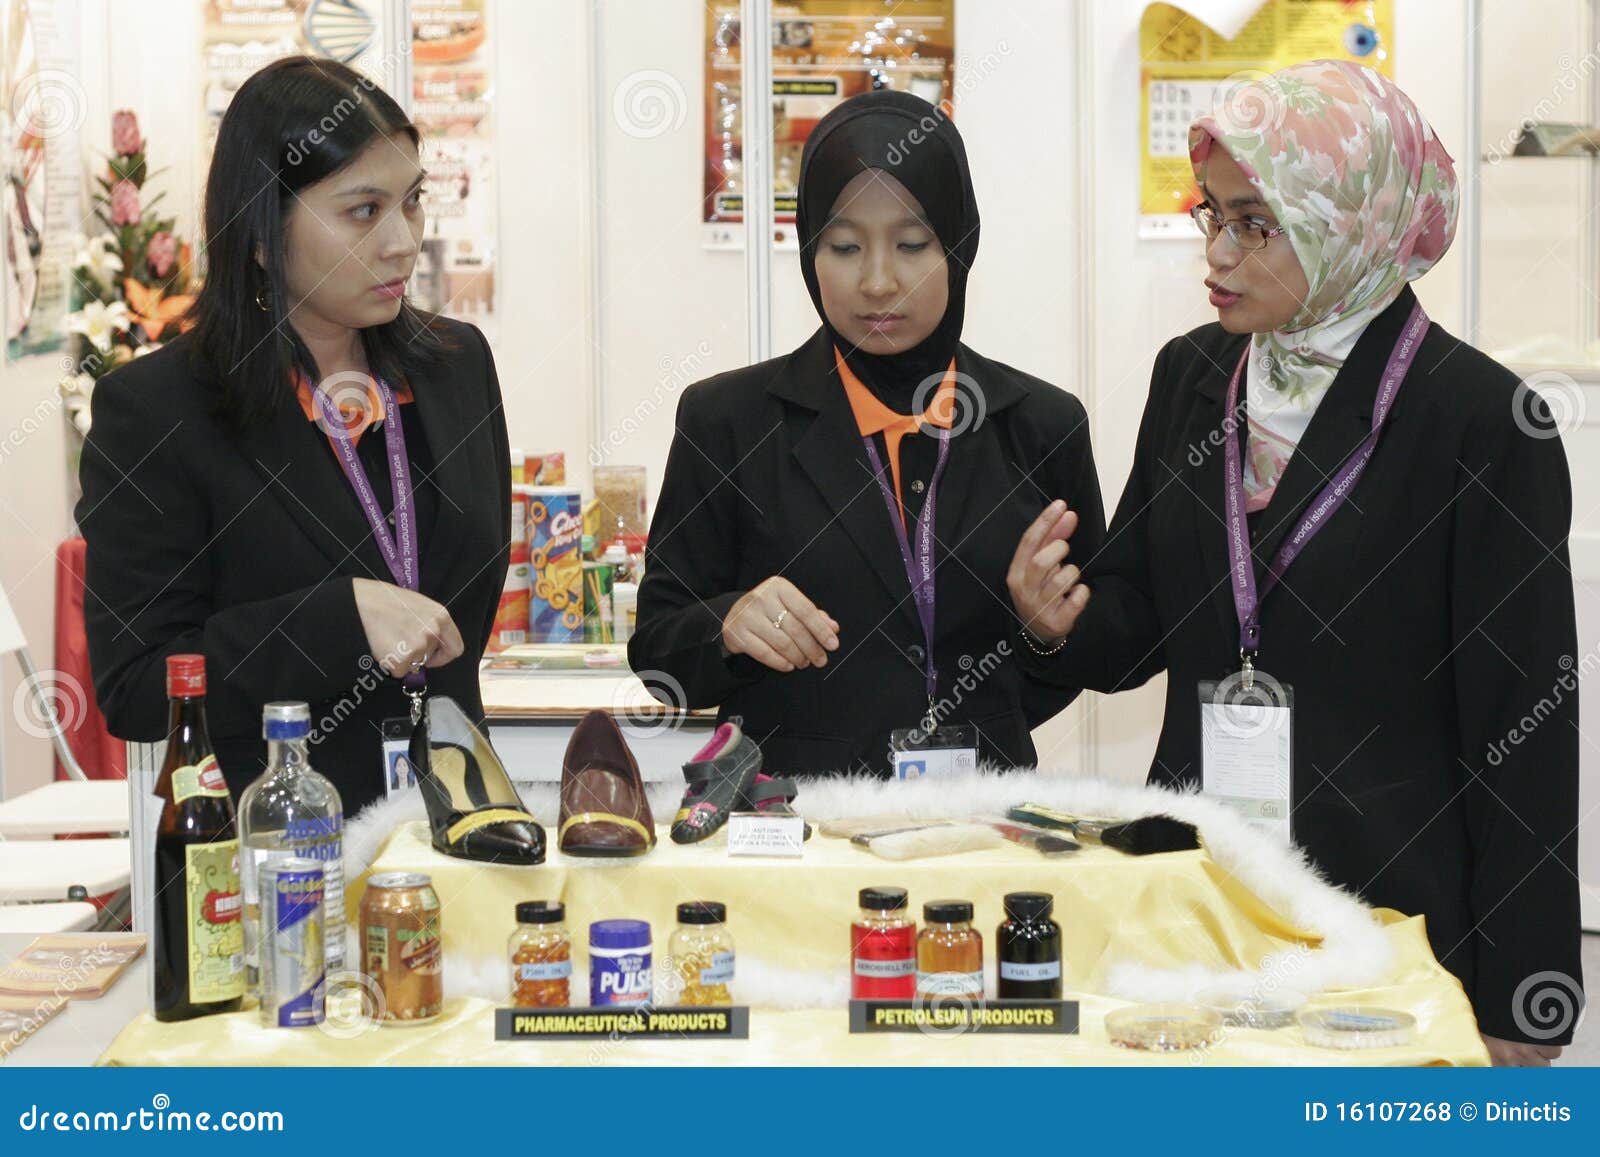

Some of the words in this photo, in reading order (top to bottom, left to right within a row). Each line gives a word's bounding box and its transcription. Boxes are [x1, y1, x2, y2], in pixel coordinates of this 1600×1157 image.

[1377, 378, 1395, 405] forum
[392, 454, 403, 477] world
[348, 461, 371, 504] economic
[396, 479, 408, 509] islamic
[1228, 485, 1240, 515] islamic
[1291, 520, 1313, 545] world
[1308, 493, 1336, 524] islamic
[1332, 456, 1367, 497] economic
[367, 503, 385, 535] islamic
[398, 511, 412, 555] economic
[380, 535, 396, 560] world
[920, 523, 929, 553] islamic
[1231, 517, 1245, 559] economic
[403, 557, 414, 584] forum
[920, 556, 930, 580] world
[1236, 561, 1248, 587] forum
[515, 1014, 646, 1033] PHARMACEUTICAL
[650, 1012, 727, 1032] PRODUCTS
[875, 1008, 968, 1025] PETROLEUM
[972, 1008, 1054, 1025] PRODUCTS
